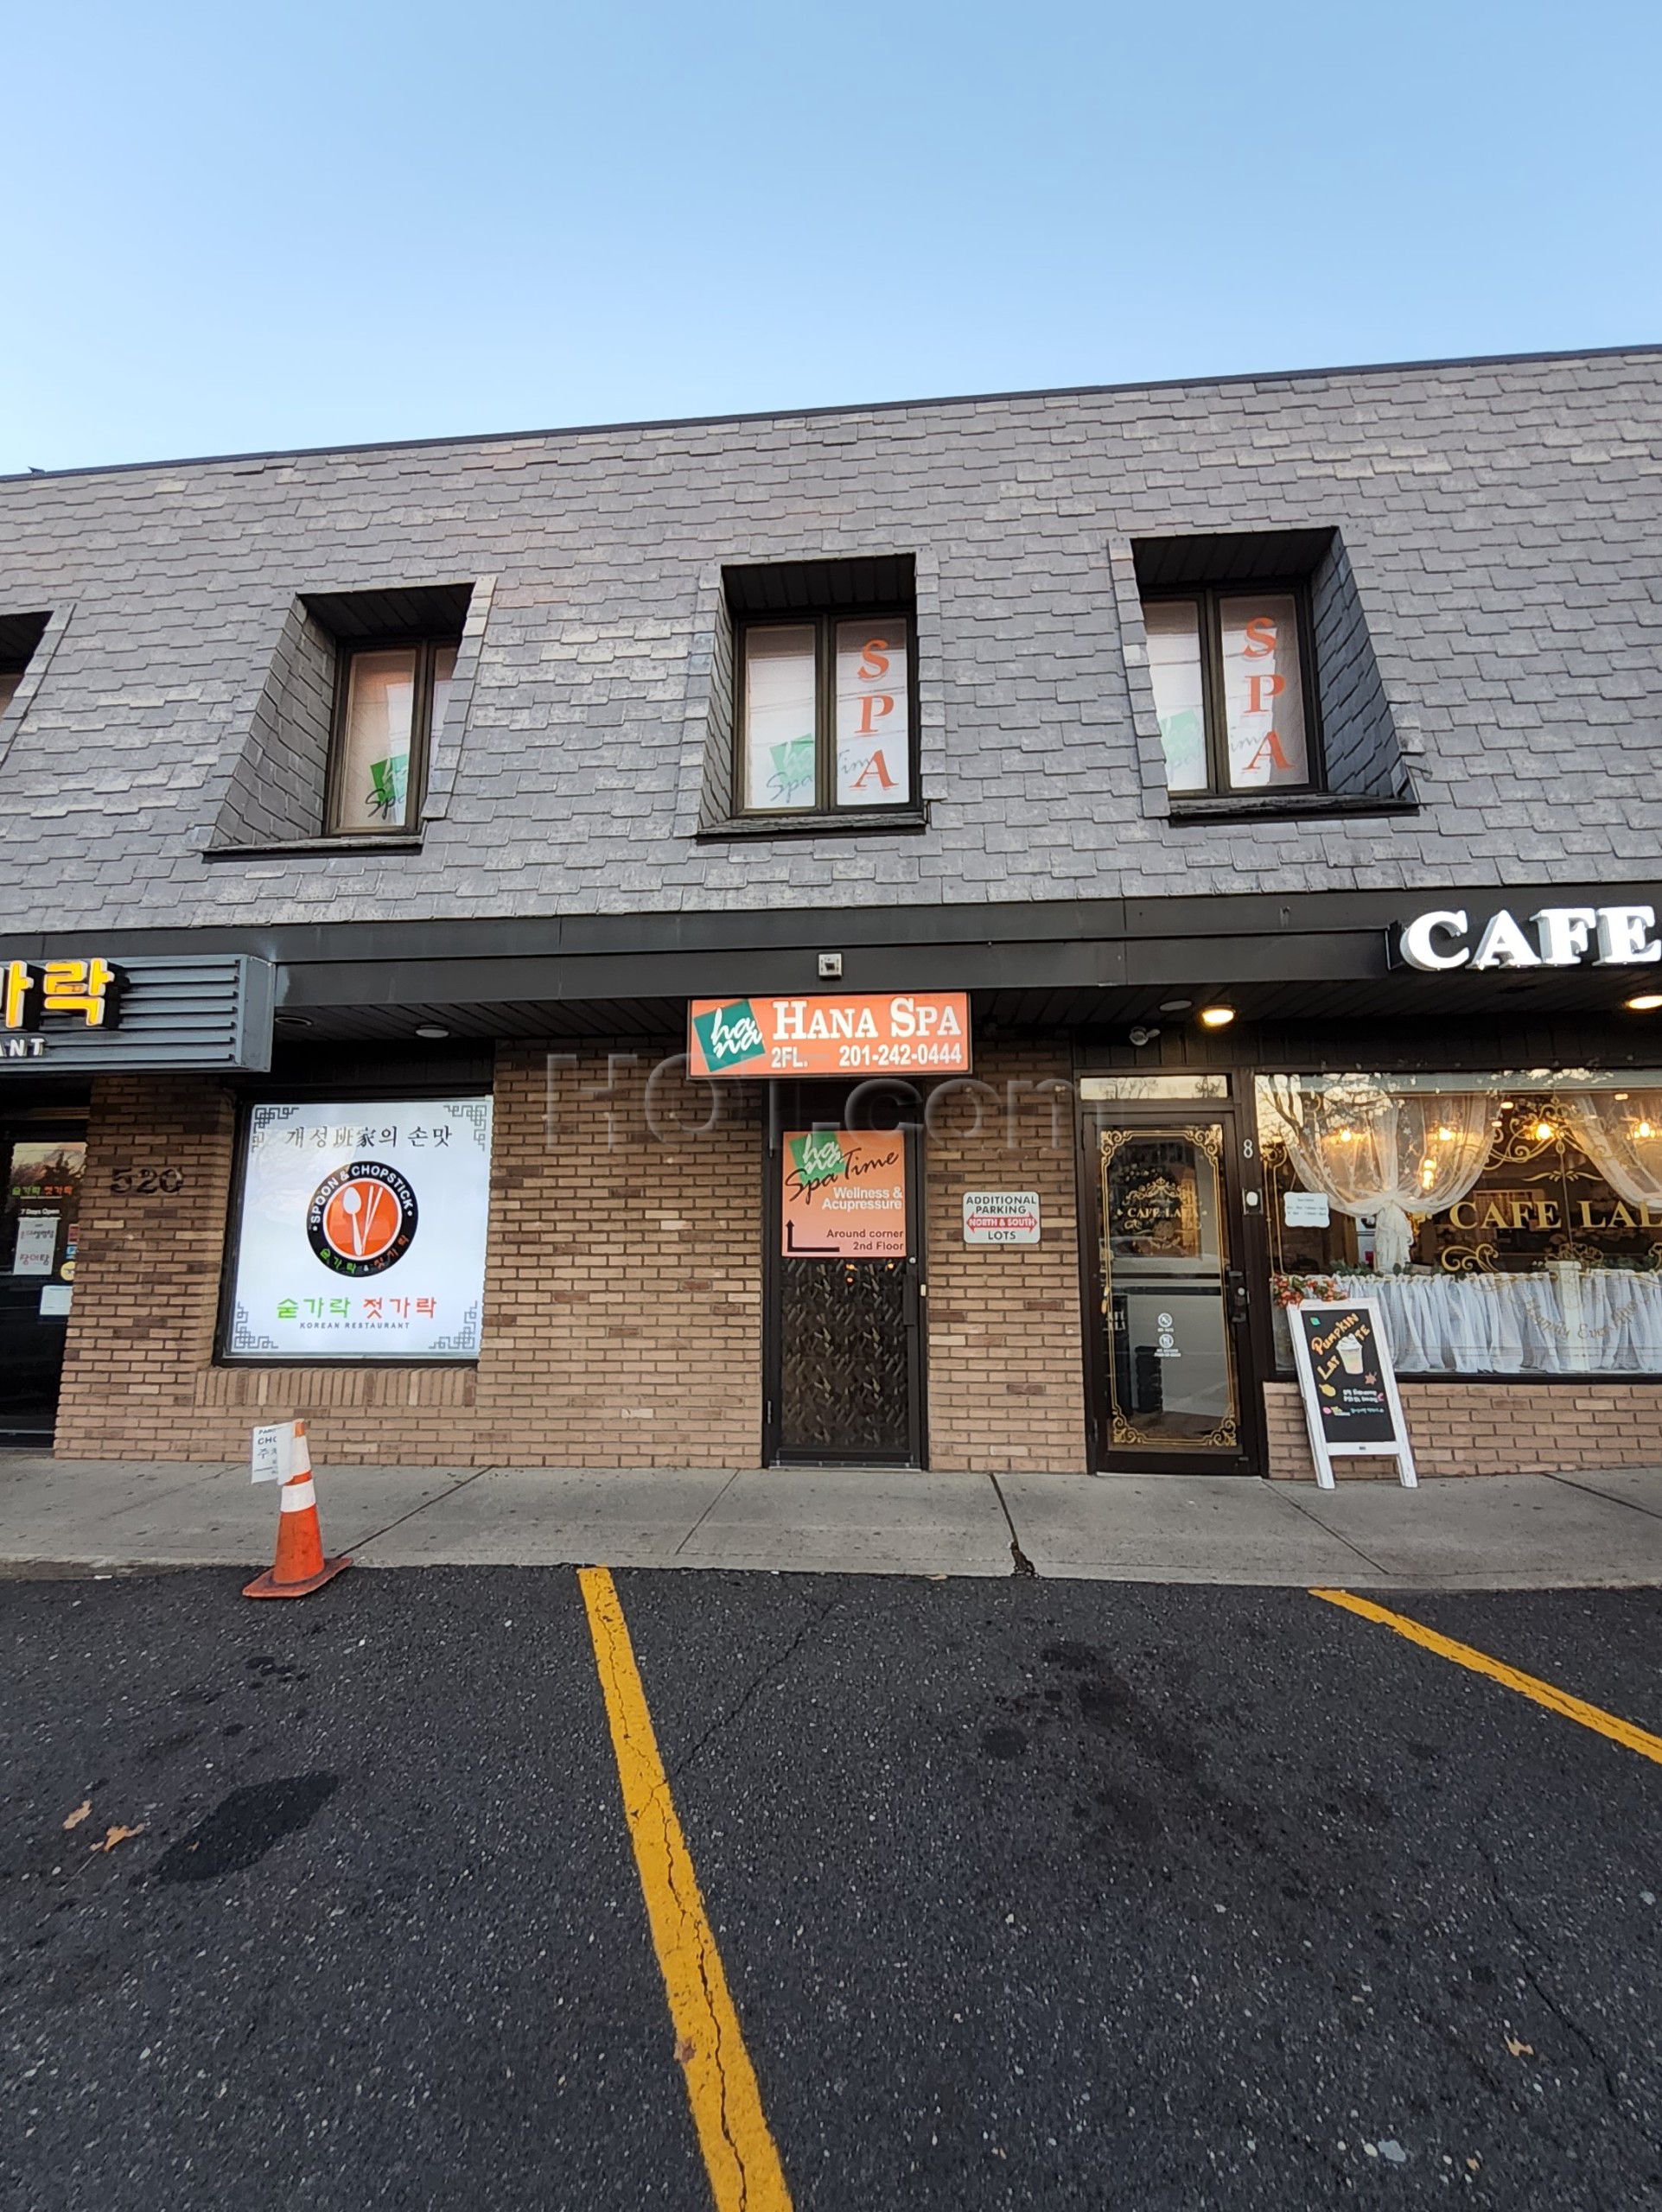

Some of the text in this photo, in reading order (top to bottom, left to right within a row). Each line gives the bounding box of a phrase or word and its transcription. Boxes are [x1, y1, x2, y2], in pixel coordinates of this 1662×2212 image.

[1242, 617, 1296, 770] SPA
[849, 639, 899, 791] SPA
[1400, 906, 1662, 971] CAFE
[771, 996, 962, 1040] HANA SPA
[771, 1043, 963, 1069] 2FL. 201-242-0444
[407, 1125, 453, 1147] 손맛
[1243, 1138, 1253, 1159] 8
[111, 1167, 183, 1193] 520
[785, 1147, 900, 1205] Spa Time
[311, 1164, 414, 1224] SPOON & CHOPSTICK
[833, 1185, 903, 1199] Wellness &
[965, 1195, 1036, 1205] ADDITIONAL
[821, 1198, 902, 1212] Acupressure
[976, 1205, 1027, 1214] PARKING
[1449, 1200, 1562, 1230] CAFE
[826, 1229, 904, 1238] Around corner
[969, 1218, 997, 1227] NORTH
[1007, 1218, 1035, 1227] SOUTH
[853, 1241, 904, 1250] 2nd Floor
[988, 1230, 1016, 1240] LOTS
[277, 1297, 437, 1319] 숟가락 젓가락
